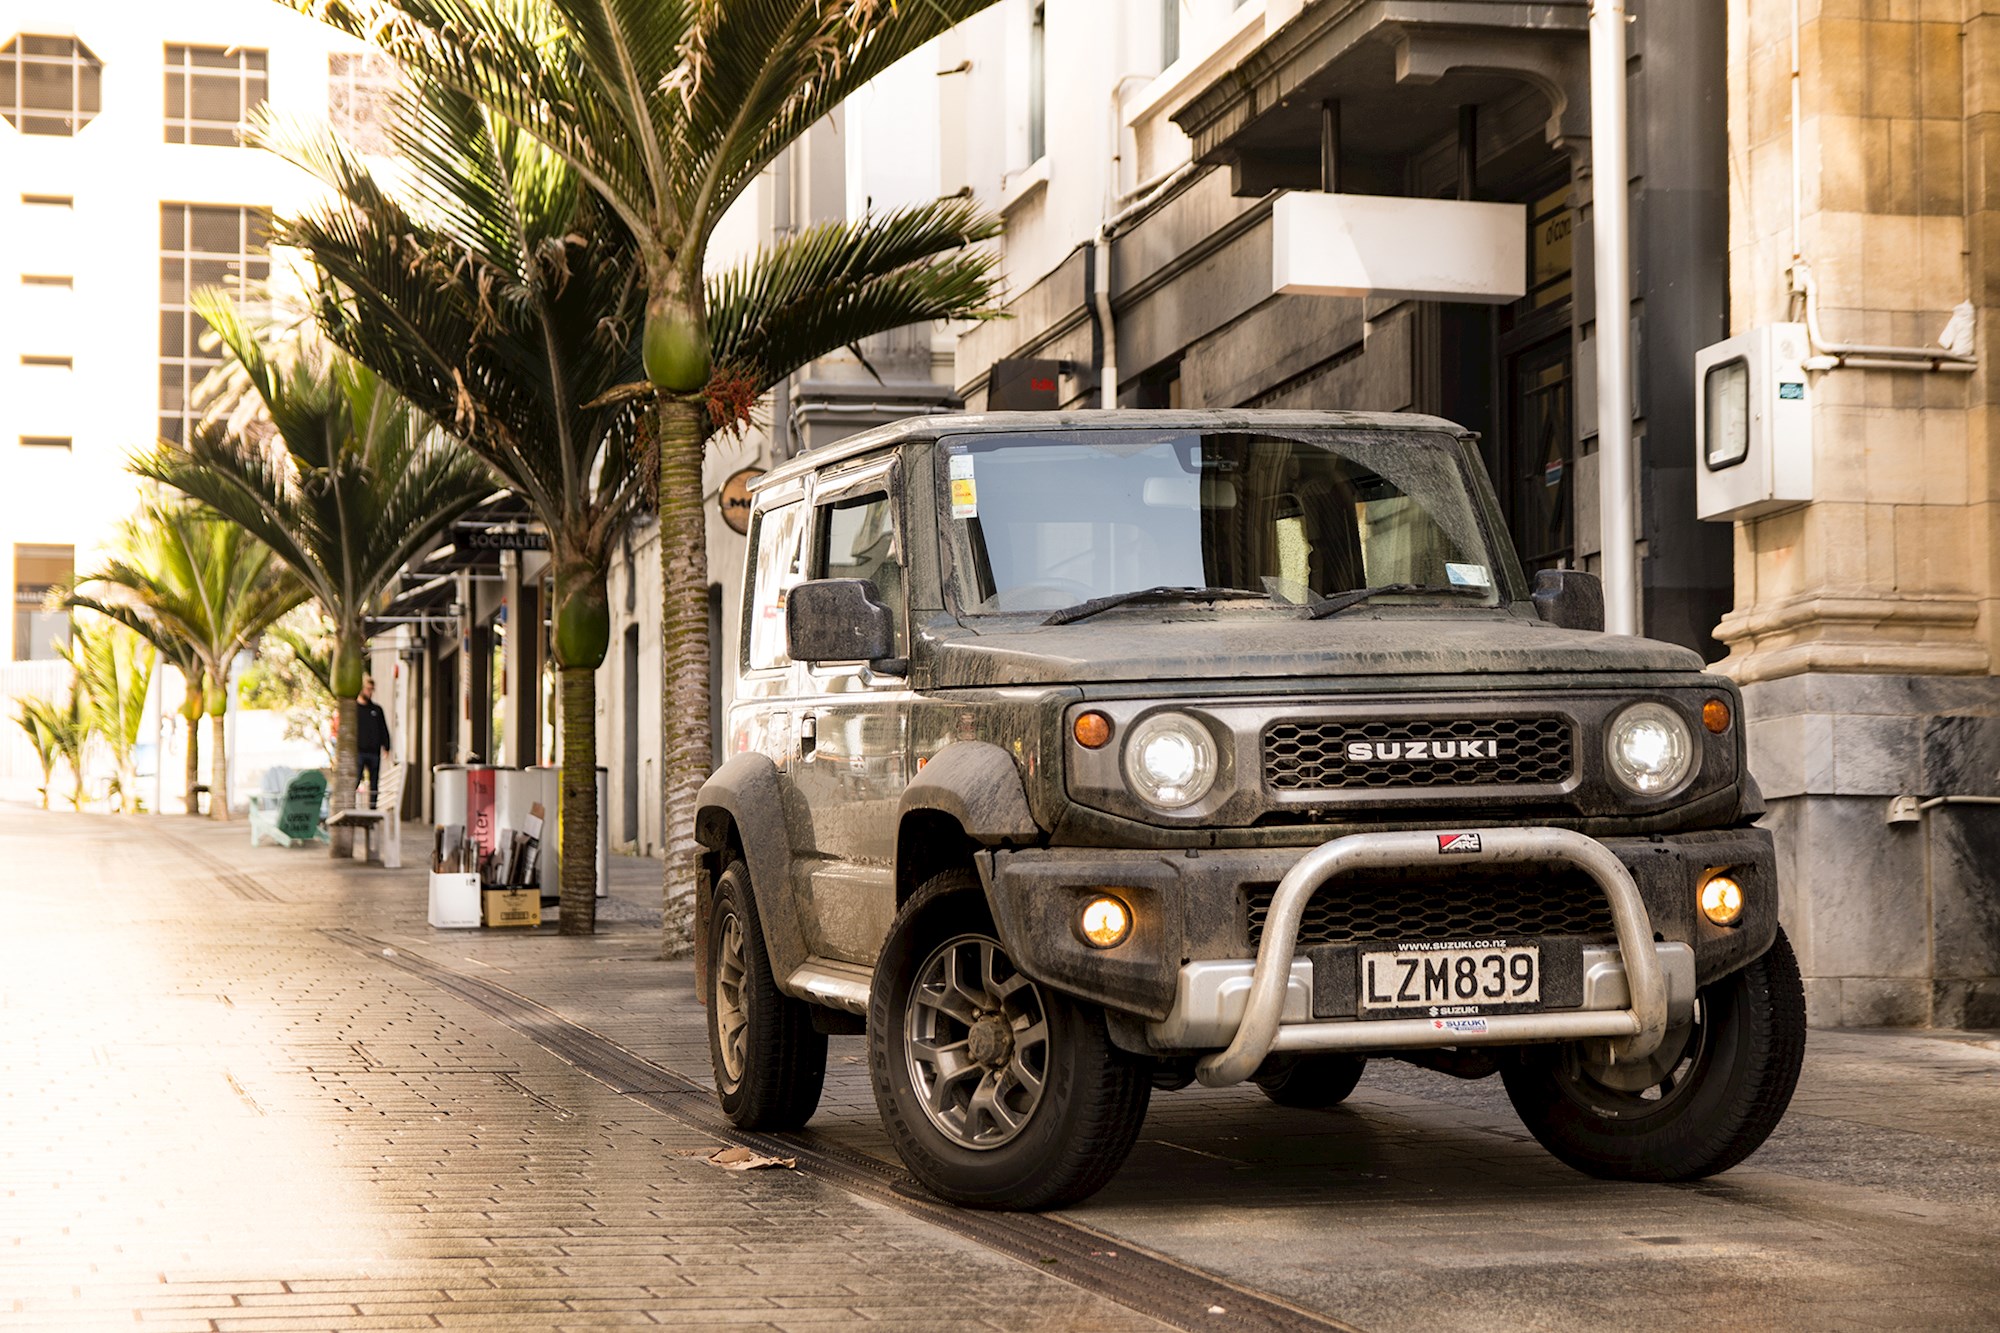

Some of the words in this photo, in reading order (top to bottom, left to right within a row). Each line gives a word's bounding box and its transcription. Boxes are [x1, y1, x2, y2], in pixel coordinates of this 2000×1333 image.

[468, 534, 546, 549] SOCIALITE
[1348, 740, 1498, 761] SUZUKI
[1450, 840, 1480, 850] ARC
[1398, 939, 1507, 952] www.suzuki.co.nz
[1368, 953, 1534, 1003] LZM839
[1440, 1005, 1479, 1015] SUZUKI
[1445, 1019, 1486, 1027] SUZUKI
